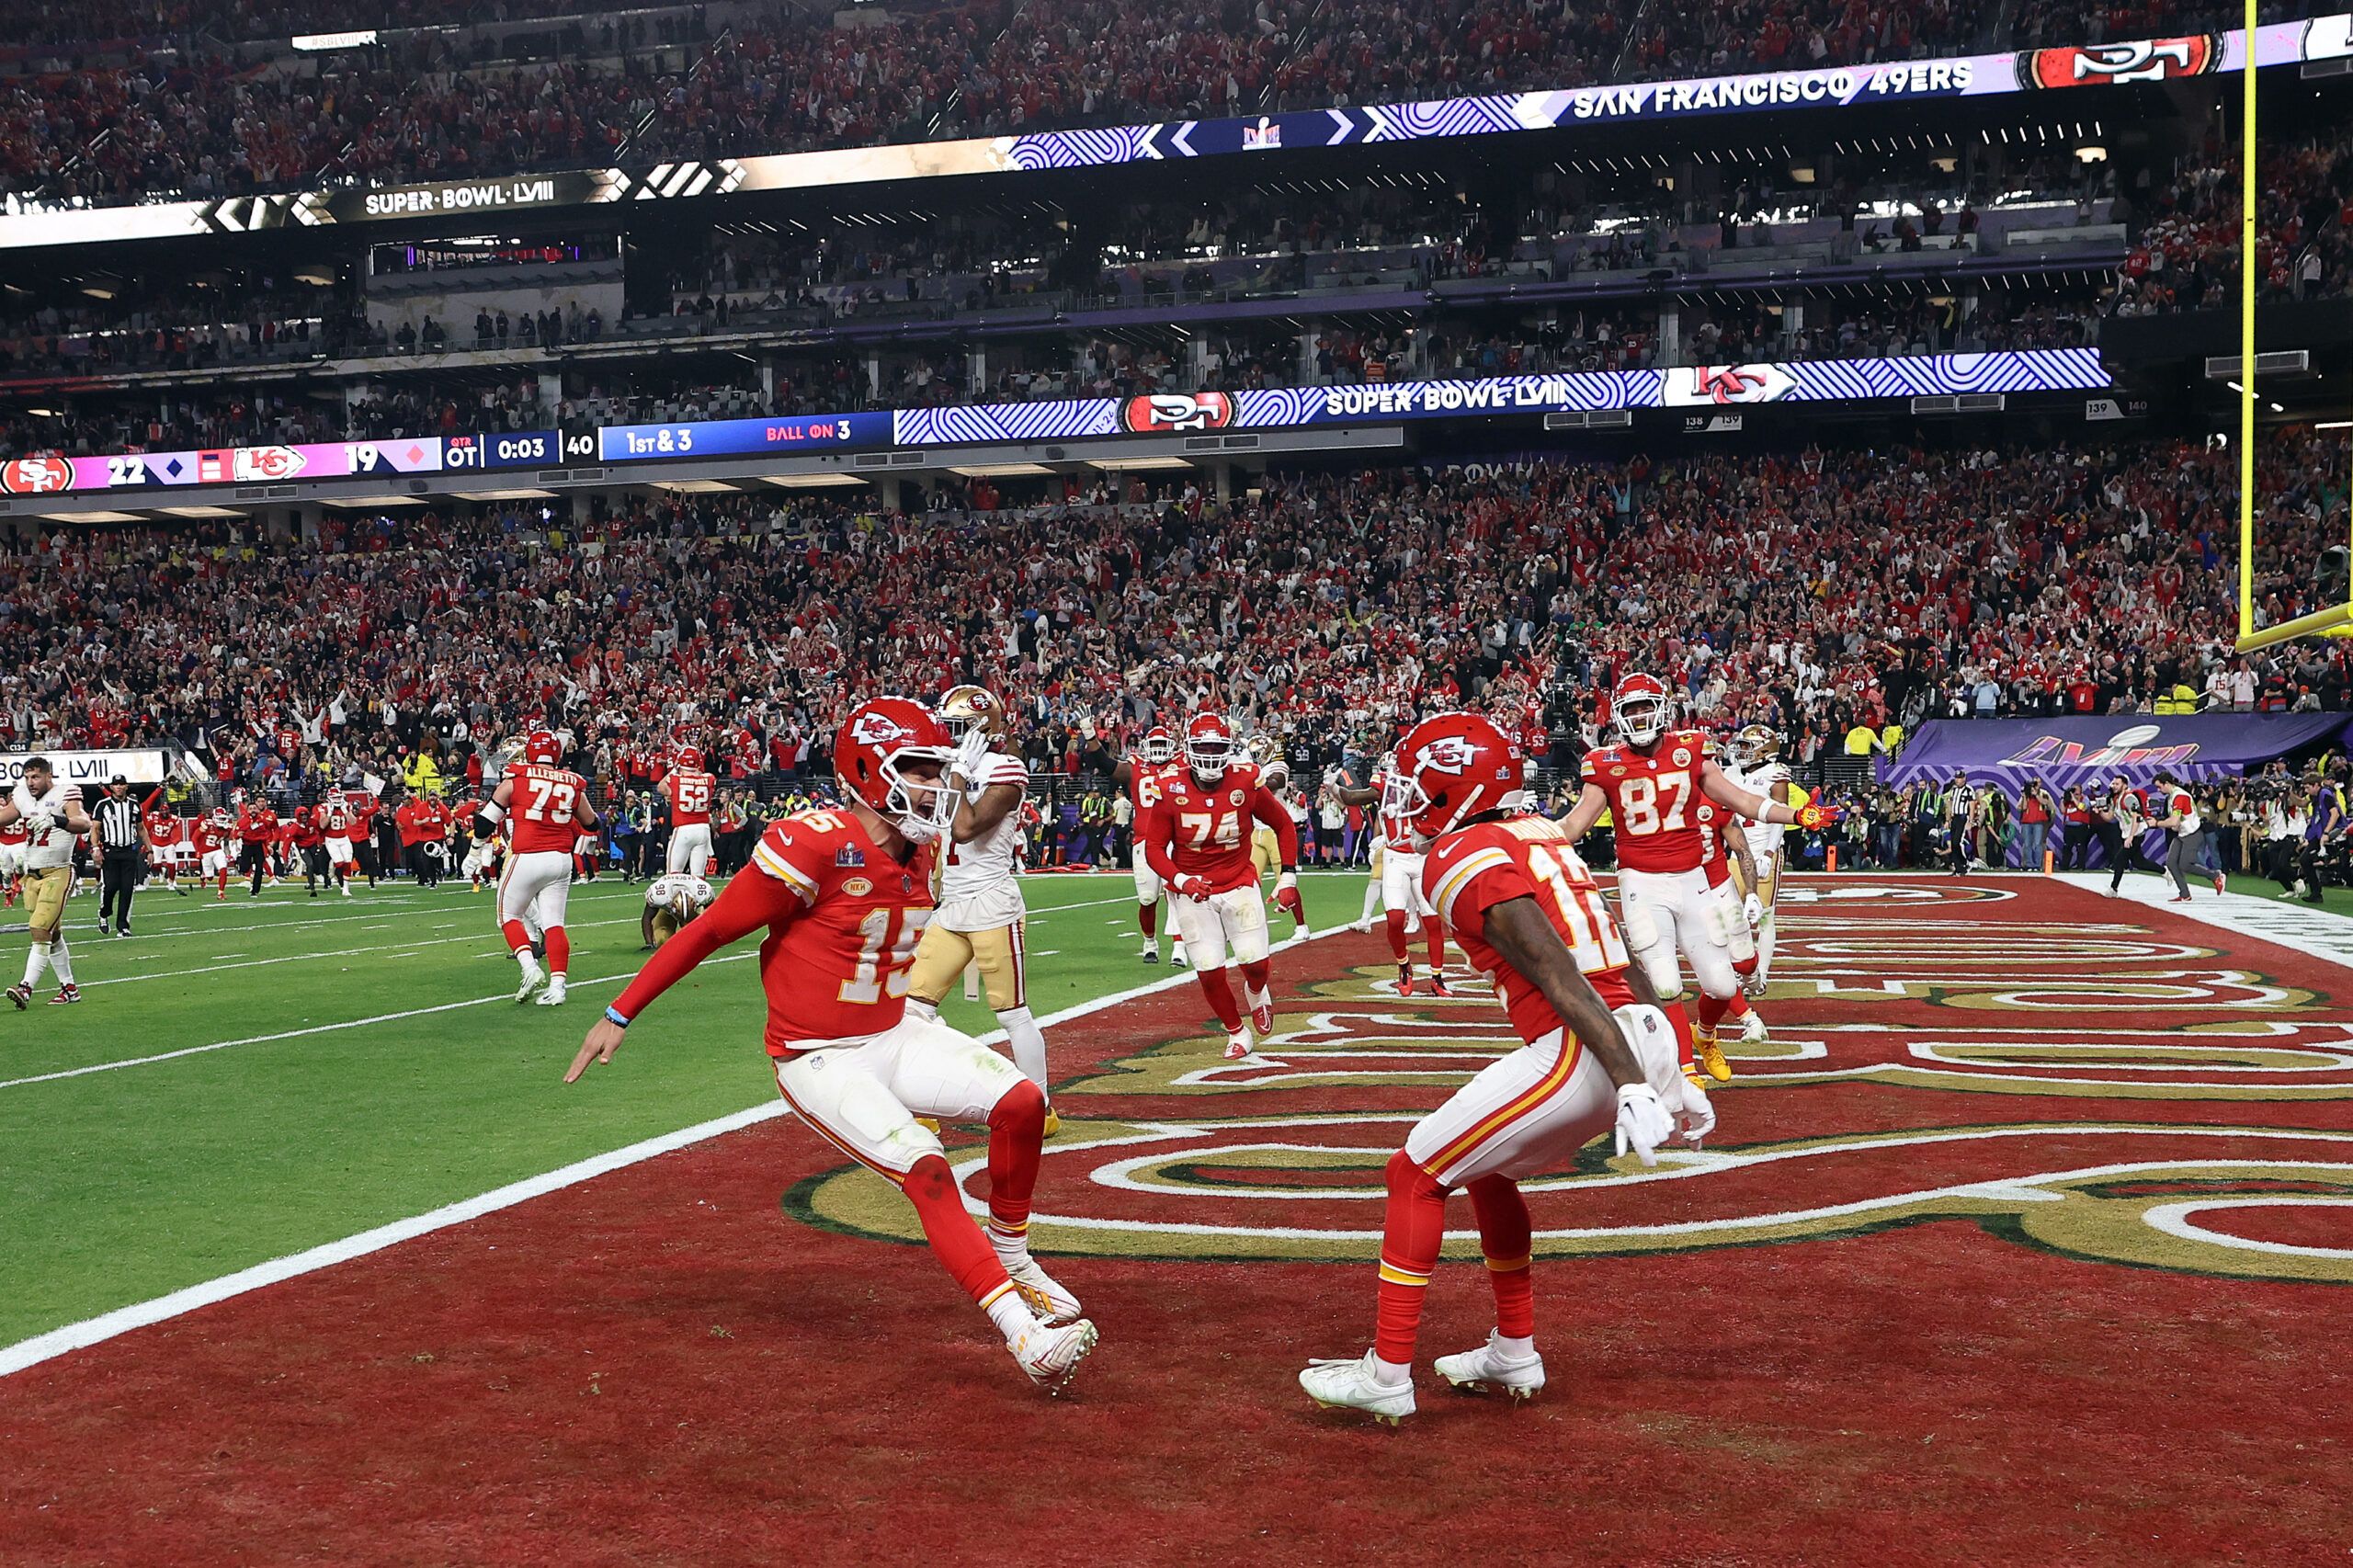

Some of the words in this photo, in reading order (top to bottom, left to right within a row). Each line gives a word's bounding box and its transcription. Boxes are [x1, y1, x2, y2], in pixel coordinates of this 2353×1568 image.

[1573, 89, 1642, 119] SAN
[1654, 70, 1856, 113] FRANCISCO
[1868, 60, 1974, 95] 49ERS
[2088, 403, 2108, 414] 139
[767, 426, 804, 442] BALL
[809, 425, 835, 439] ON
[837, 420, 852, 440] 3
[1685, 416, 1704, 426] 138
[1722, 416, 1740, 426] 139
[450, 437, 472, 448] QTR
[497, 437, 546, 460] 0:03
[565, 435, 594, 457] 40
[344, 443, 378, 472] 19
[447, 446, 478, 468] OT
[107, 457, 146, 485] 22
[2215, 679, 2226, 690] 15
[9, 744, 27, 752] C134
[281, 736, 293, 748] 15
[1532, 734, 1545, 747] 53
[69, 759, 108, 778] LVIII
[524, 778, 575, 824] 73
[678, 785, 710, 812] 52
[1618, 768, 1692, 836] 87
[330, 814, 347, 831] 81
[1180, 810, 1241, 853] 74
[1527, 844, 1631, 975] 12
[836, 905, 934, 1006] 15
